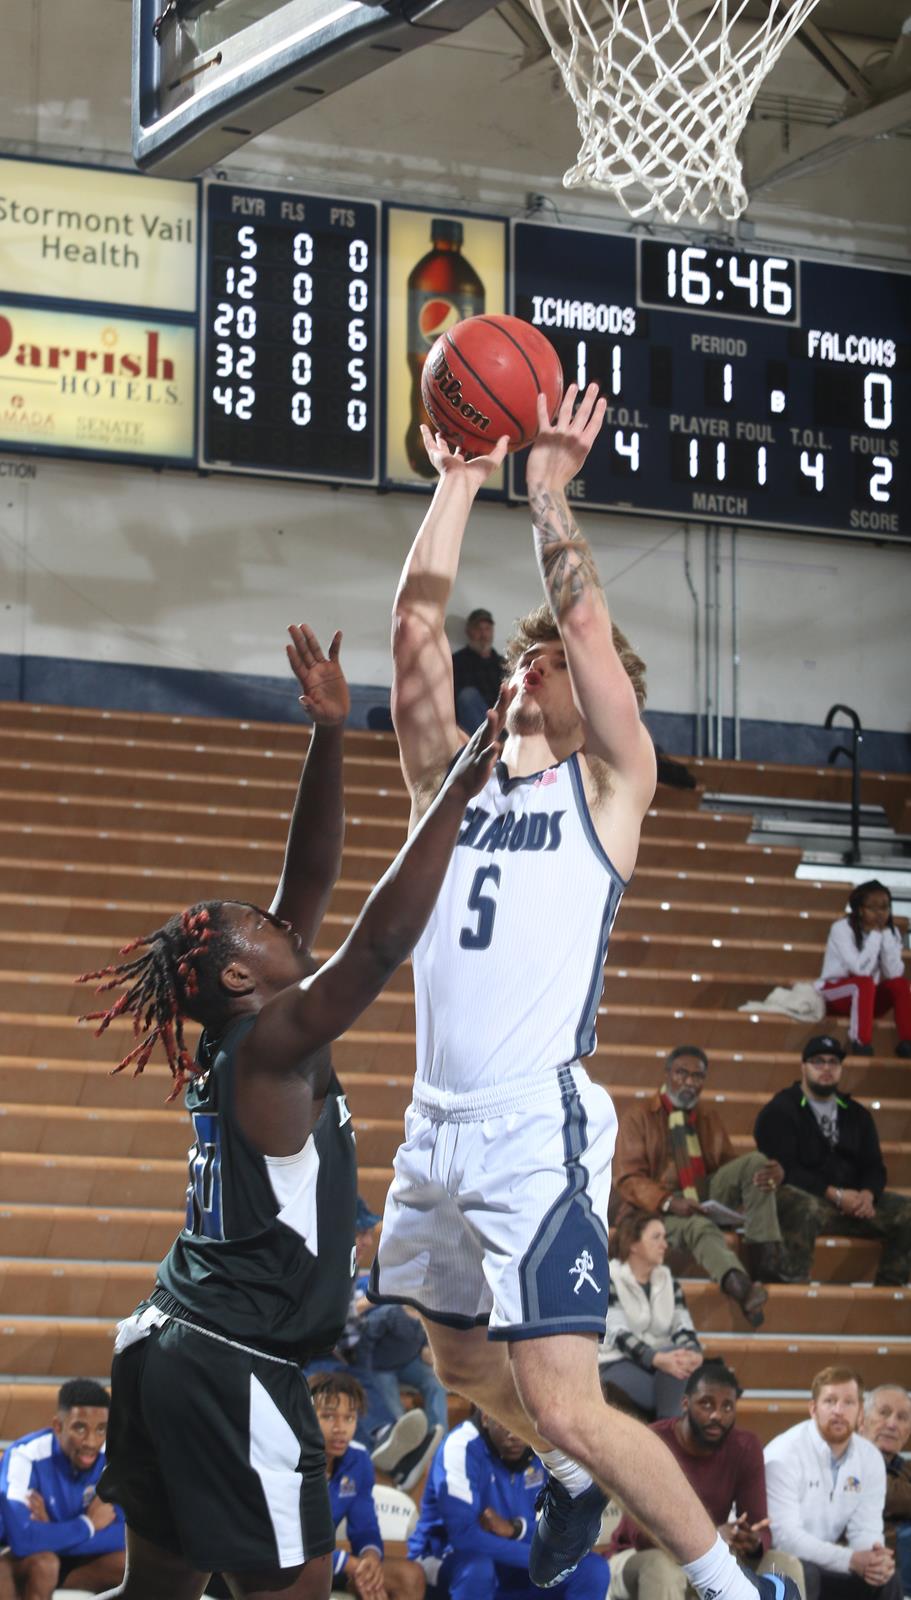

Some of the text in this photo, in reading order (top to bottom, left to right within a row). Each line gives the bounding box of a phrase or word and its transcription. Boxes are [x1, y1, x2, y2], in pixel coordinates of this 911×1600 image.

[0, 196, 192, 243] Stormont Vail
[231, 195, 355, 228] PLYR FLS PTS
[41, 235, 140, 269] Health
[237, 225, 369, 273] 5 0 0
[225, 265, 368, 313] 12 0 0
[667, 247, 792, 316] 16:46
[213, 302, 368, 352] 20 0 6
[531, 296, 636, 336] ICHABODS
[690, 333, 748, 357] PERIOD
[807, 329, 897, 368] FALCONS
[216, 342, 367, 392] 32 0 5
[577, 340, 621, 395] 11
[723, 362, 733, 403] 1
[60, 376, 182, 405] HOTELS
[212, 385, 367, 432] 42 0 0
[431, 348, 491, 433] Wilson
[863, 372, 893, 430] 0
[607, 406, 649, 429] T.O.L.
[669, 414, 775, 444] PLAYER FOUL
[614, 430, 640, 472] 4
[790, 427, 832, 450] T.O.L.
[850, 435, 899, 457] FOULS
[800, 451, 824, 492] 4
[869, 456, 894, 503] 2
[692, 492, 748, 516] MATCH
[850, 509, 899, 531] SCORE
[459, 863, 501, 950] 5
